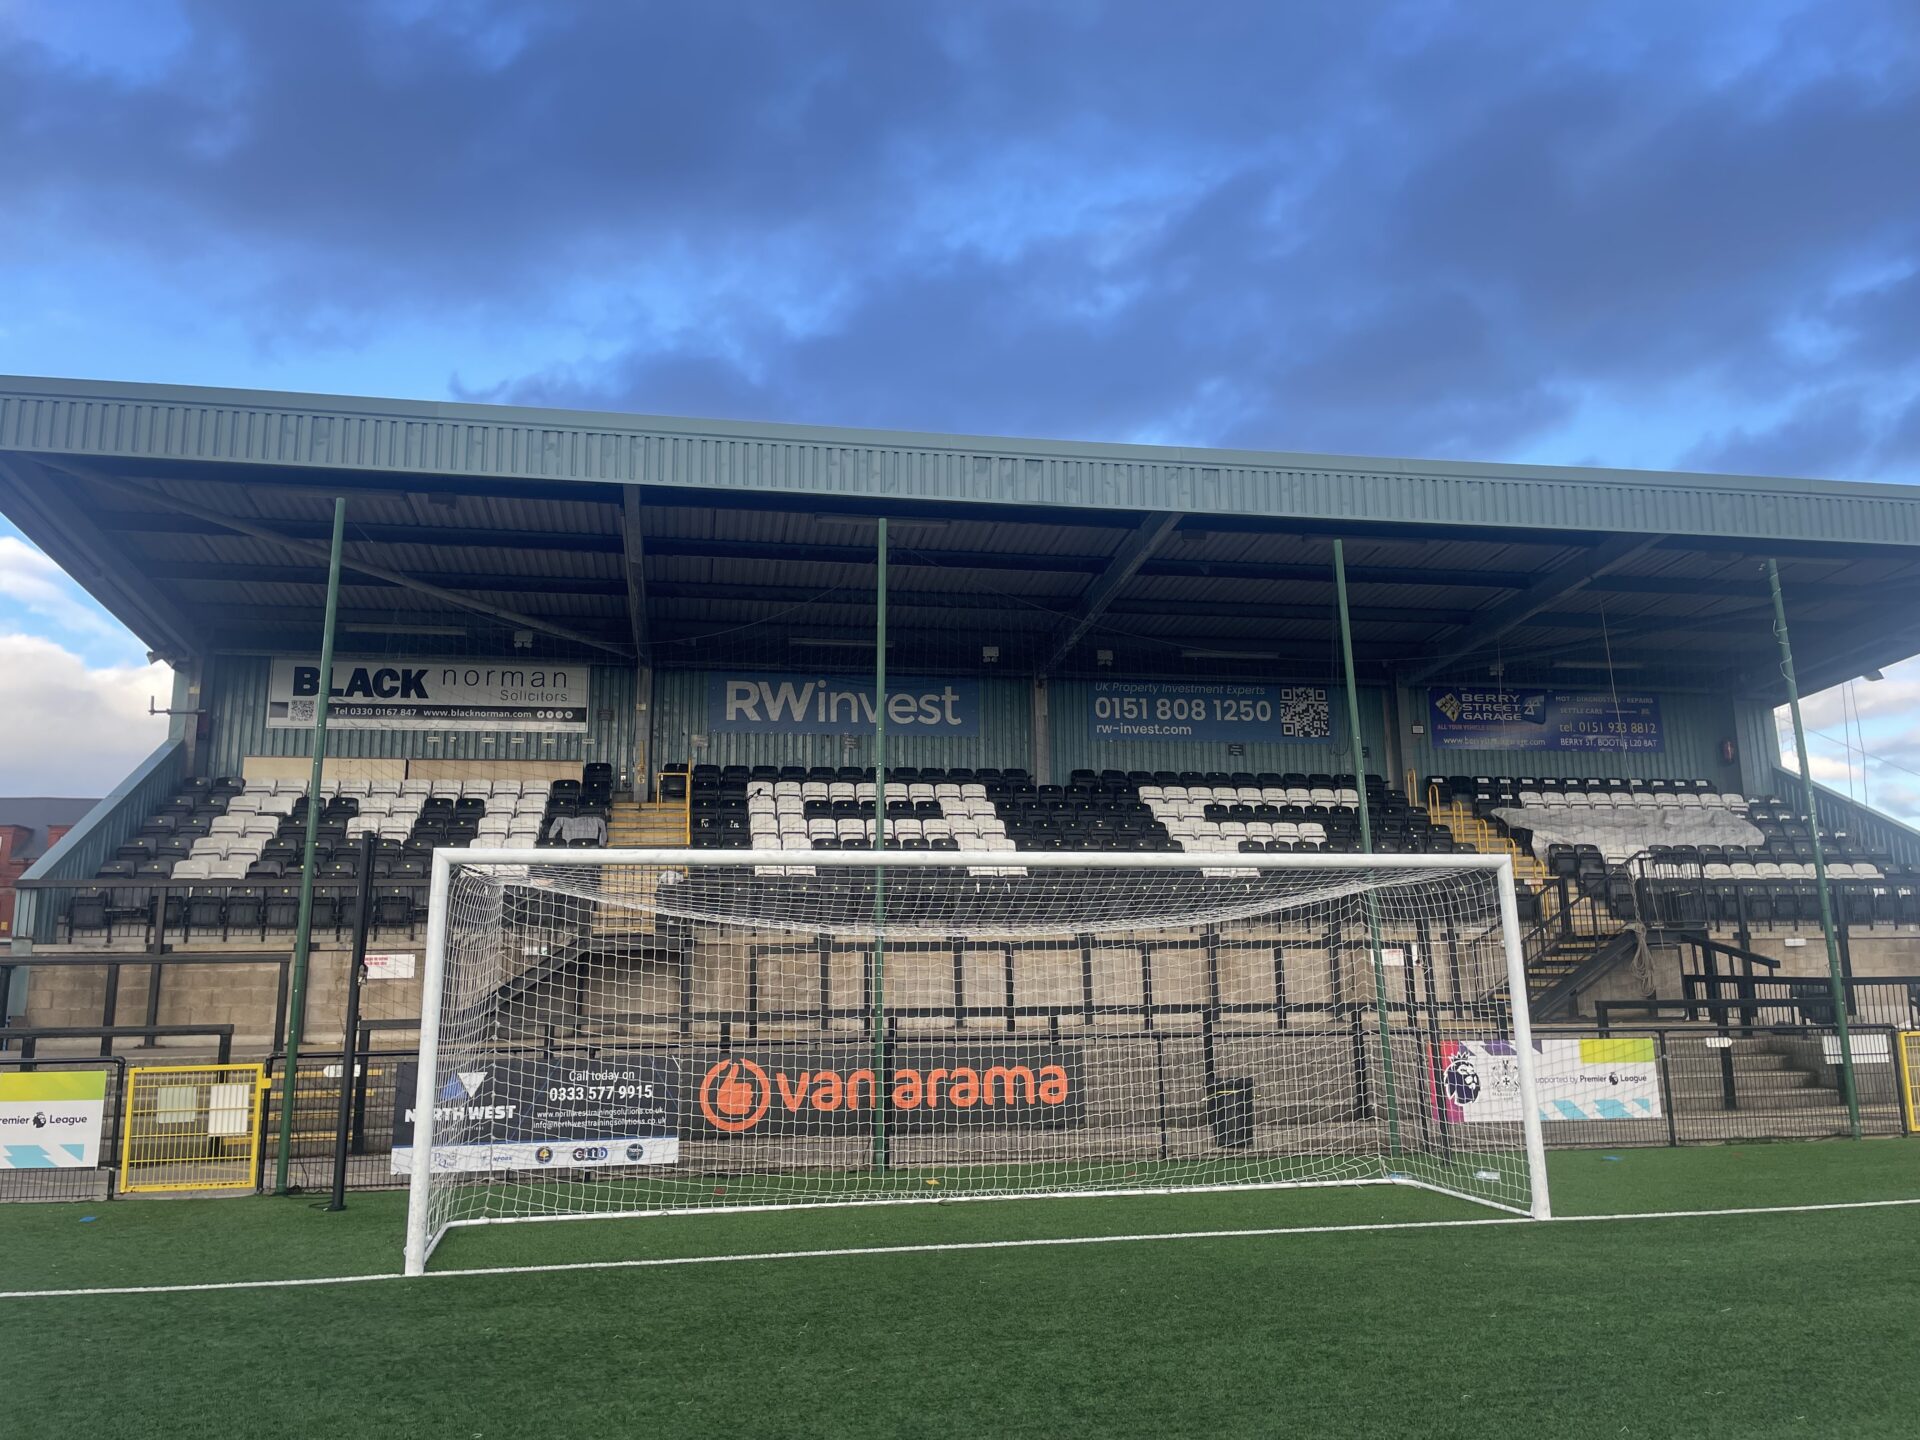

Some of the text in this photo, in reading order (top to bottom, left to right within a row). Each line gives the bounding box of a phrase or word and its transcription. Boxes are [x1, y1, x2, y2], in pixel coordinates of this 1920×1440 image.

[293, 667, 567, 698] BLACK norman
[500, 689, 568, 702] Solicitors
[1095, 682, 1266, 697] UK Property Investment Experts
[726, 679, 962, 726] RWinvest
[1461, 693, 1520, 703] BERRY
[335, 707, 532, 718] Tel 0330 0167 847 www.blacknorman.com
[1095, 697, 1272, 722] 0151 808 1250
[1462, 703, 1521, 712] STREET
[1462, 712, 1522, 721] GARAGE
[1096, 722, 1192, 736] rw-invest.com
[1578, 721, 1603, 733] 0151
[1607, 722, 1627, 733] 933
[1630, 723, 1657, 734] 8812
[1560, 738, 1583, 746] BERRY
[569, 1069, 635, 1083] Call today on
[1535, 1074, 1647, 1085] upported by Premier League
[549, 1084, 653, 1102] 0333 577 9915
[404, 1104, 517, 1122] NRTH WEST
[49, 1114, 88, 1126] League
